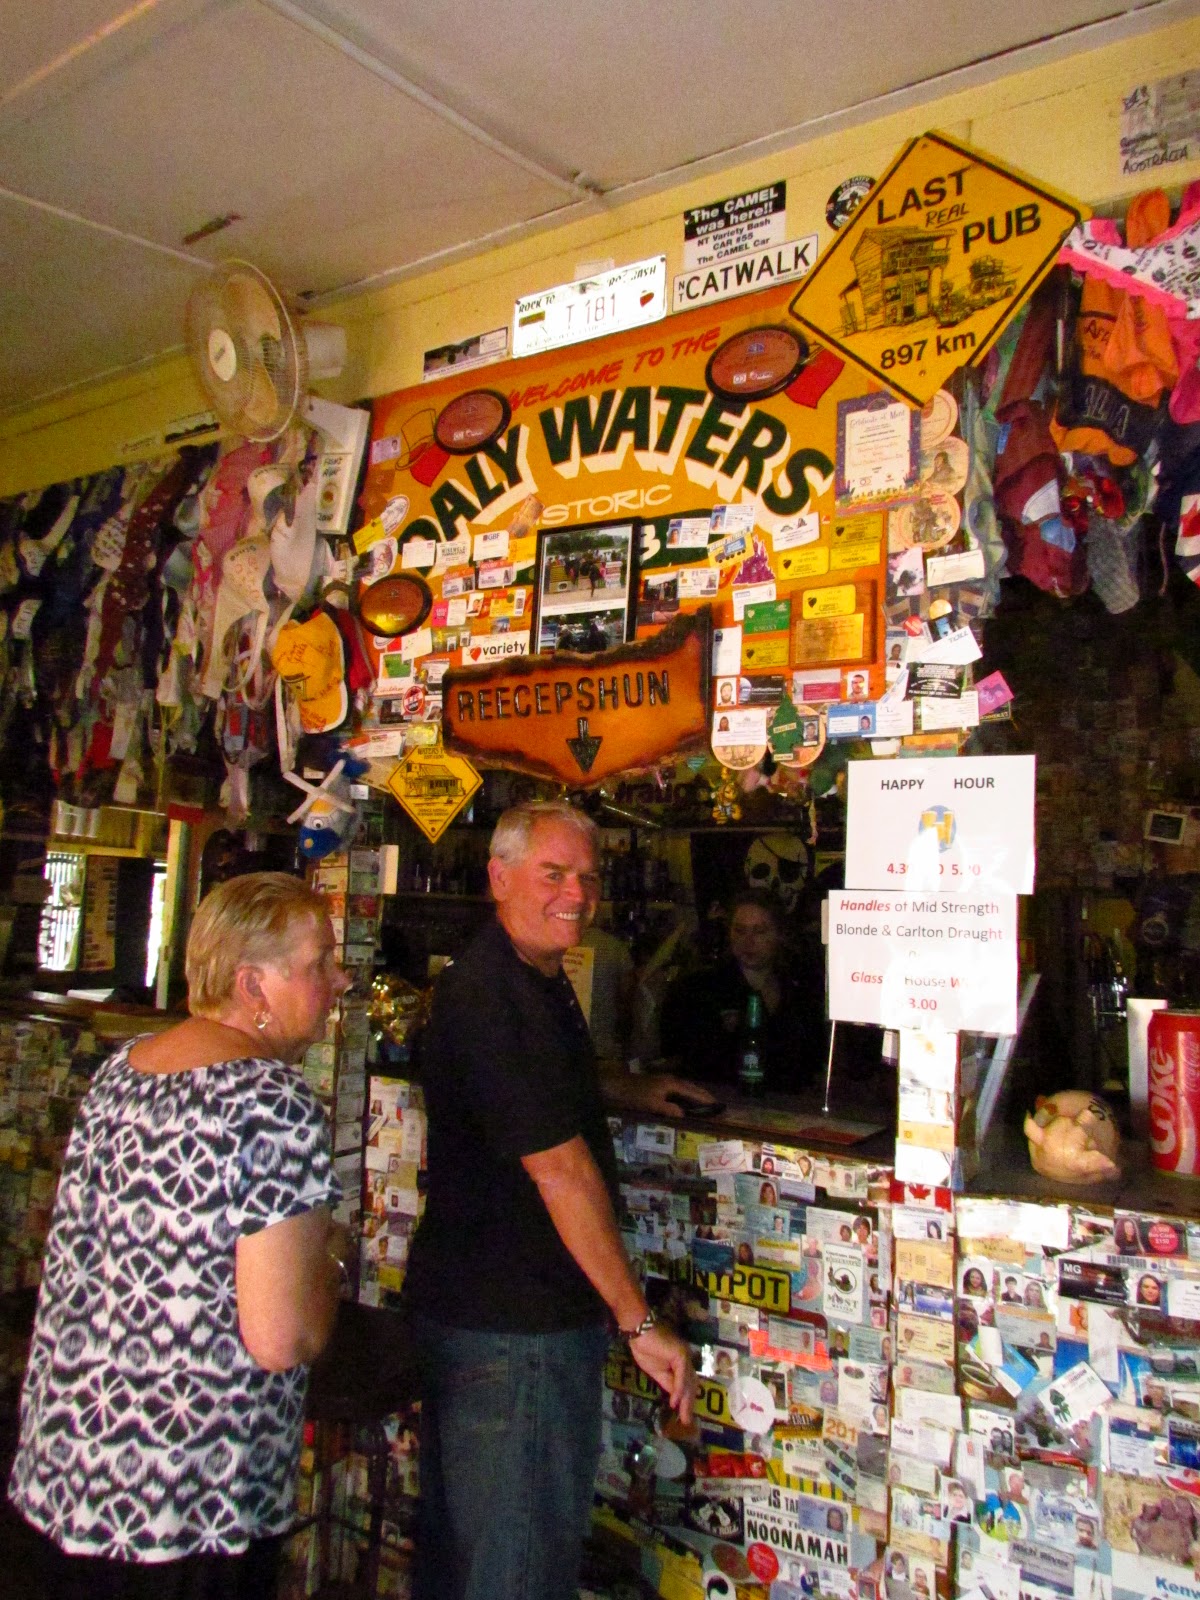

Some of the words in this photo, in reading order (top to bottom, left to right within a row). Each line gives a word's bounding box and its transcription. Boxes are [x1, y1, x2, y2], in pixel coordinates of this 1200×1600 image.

[691, 209, 720, 224] The
[723, 186, 779, 214] CAMEL
[877, 165, 974, 226] LAST
[696, 218, 726, 236] was
[730, 201, 774, 226] here!!
[925, 202, 971, 229] REAL
[962, 202, 1043, 255] PUB
[697, 237, 711, 248] NT
[712, 226, 745, 242] Variety
[747, 218, 771, 231] Bash
[713, 238, 734, 251] CAR
[697, 255, 715, 265] The
[716, 242, 751, 260] CAMEL
[753, 237, 771, 248] Car
[685, 242, 811, 301] CATWALK
[880, 337, 928, 371] 897
[935, 327, 978, 358] km
[508, 360, 622, 412] WELCOME
[633, 349, 667, 374] TO
[671, 327, 721, 359] THE
[539, 385, 835, 522] WATERS
[482, 640, 527, 656] variety
[457, 669, 670, 723] REECEPSHUN
[880, 779, 925, 791] HAPPY
[953, 776, 996, 790] HOUR
[887, 862, 908, 876] 4.3
[840, 899, 891, 913] Handles
[911, 901, 938, 913] Mid
[941, 901, 999, 917] Strength
[836, 923, 878, 936] Blonde
[881, 924, 892, 936] &
[896, 925, 943, 938] Carlton
[947, 926, 1003, 942] Draught
[850, 971, 884, 985] Glass
[904, 975, 946, 987] House
[1063, 1262, 1082, 1275] MG
[746, 1518, 849, 1567] NOONAMAH
